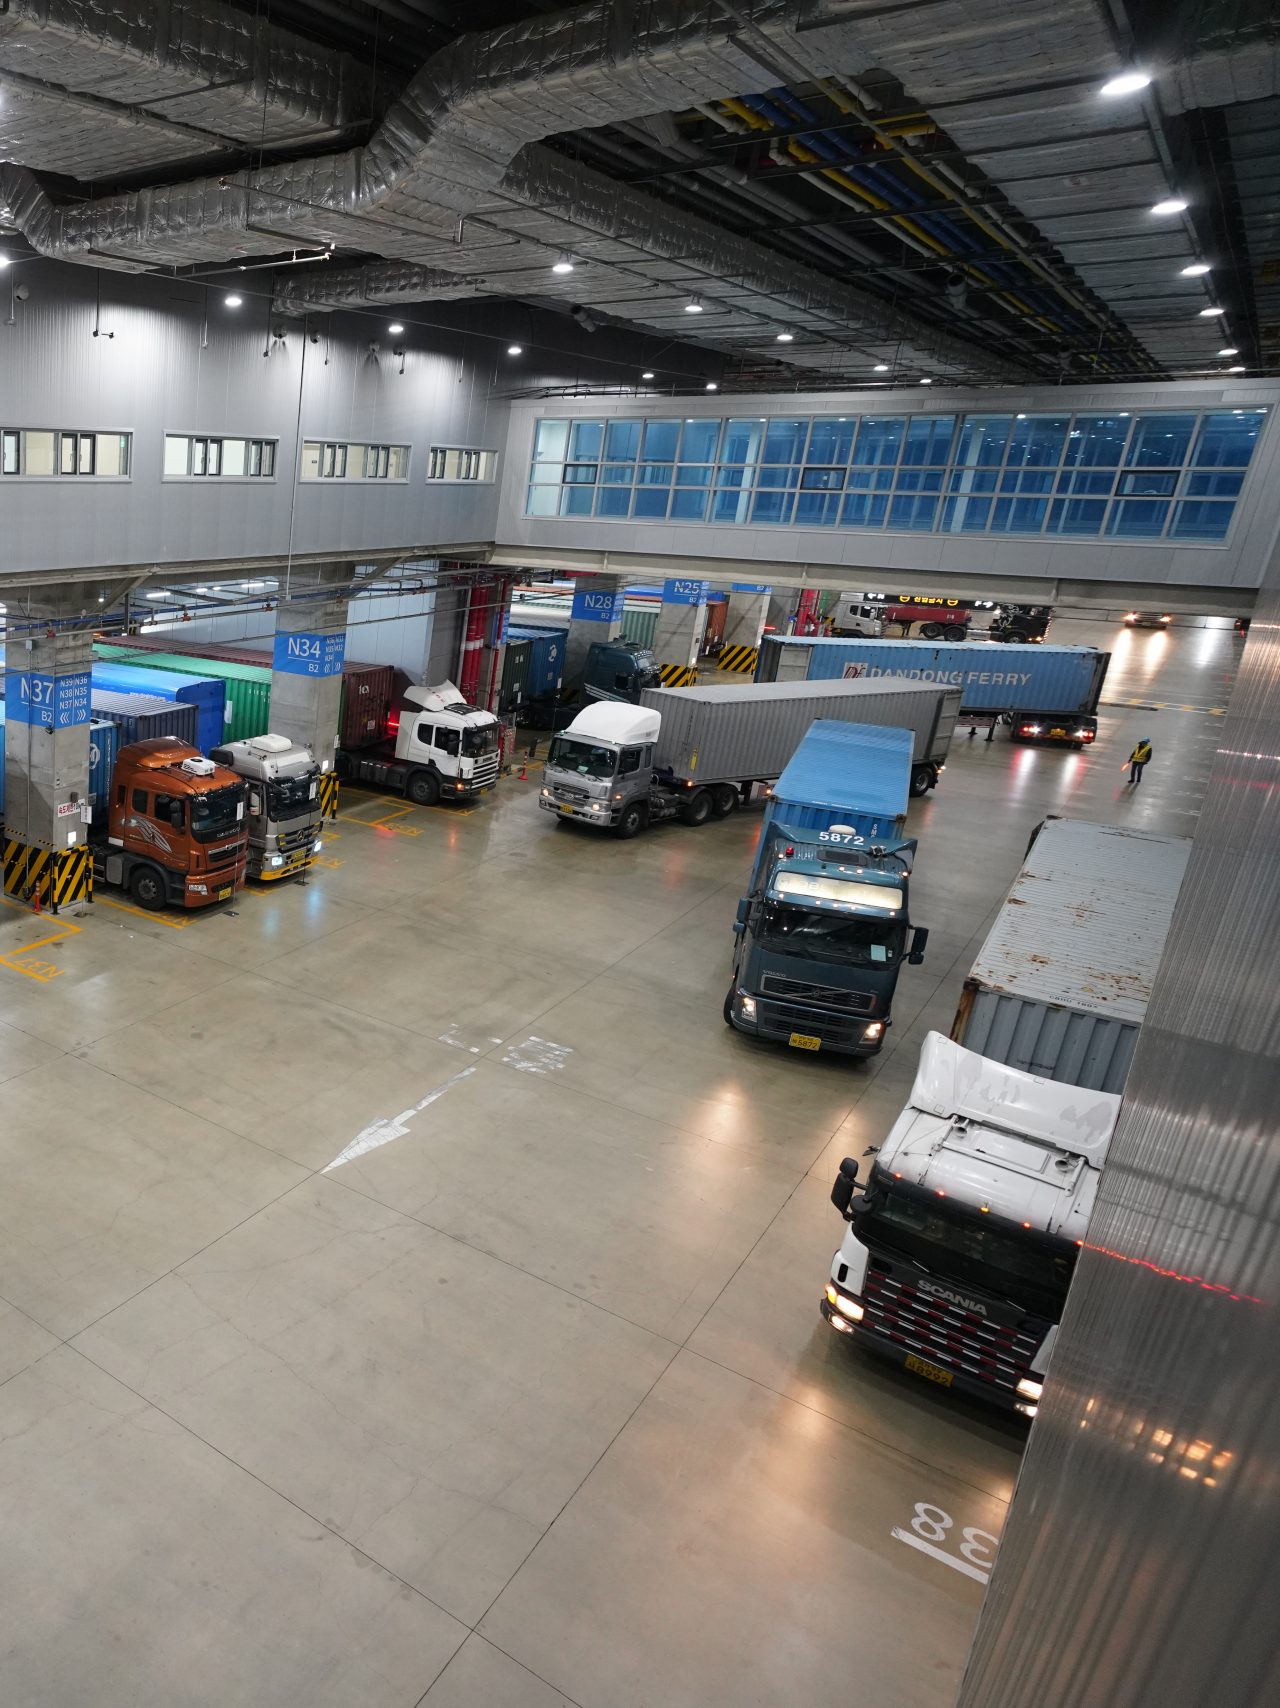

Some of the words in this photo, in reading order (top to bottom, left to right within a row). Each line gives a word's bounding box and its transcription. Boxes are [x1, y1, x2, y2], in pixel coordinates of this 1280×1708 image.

[675, 580, 700, 594] N25
[585, 594, 612, 609] N28
[288, 637, 321, 658] N34
[308, 663, 319, 673] B2
[60, 679, 73, 687] N39
[74, 676, 88, 685] N36
[871, 668, 962, 684] DANDONG
[966, 672, 1032, 686] FERRY
[20, 677, 54, 704] N37
[60, 690, 73, 699] N38
[74, 687, 88, 696] N35
[59, 700, 72, 710] N37
[74, 698, 87, 707] N34
[41, 710, 53, 722] B2
[819, 831, 864, 845] 5872
[15, 957, 65, 979] N37
[917, 1279, 988, 1316] SCANIA
